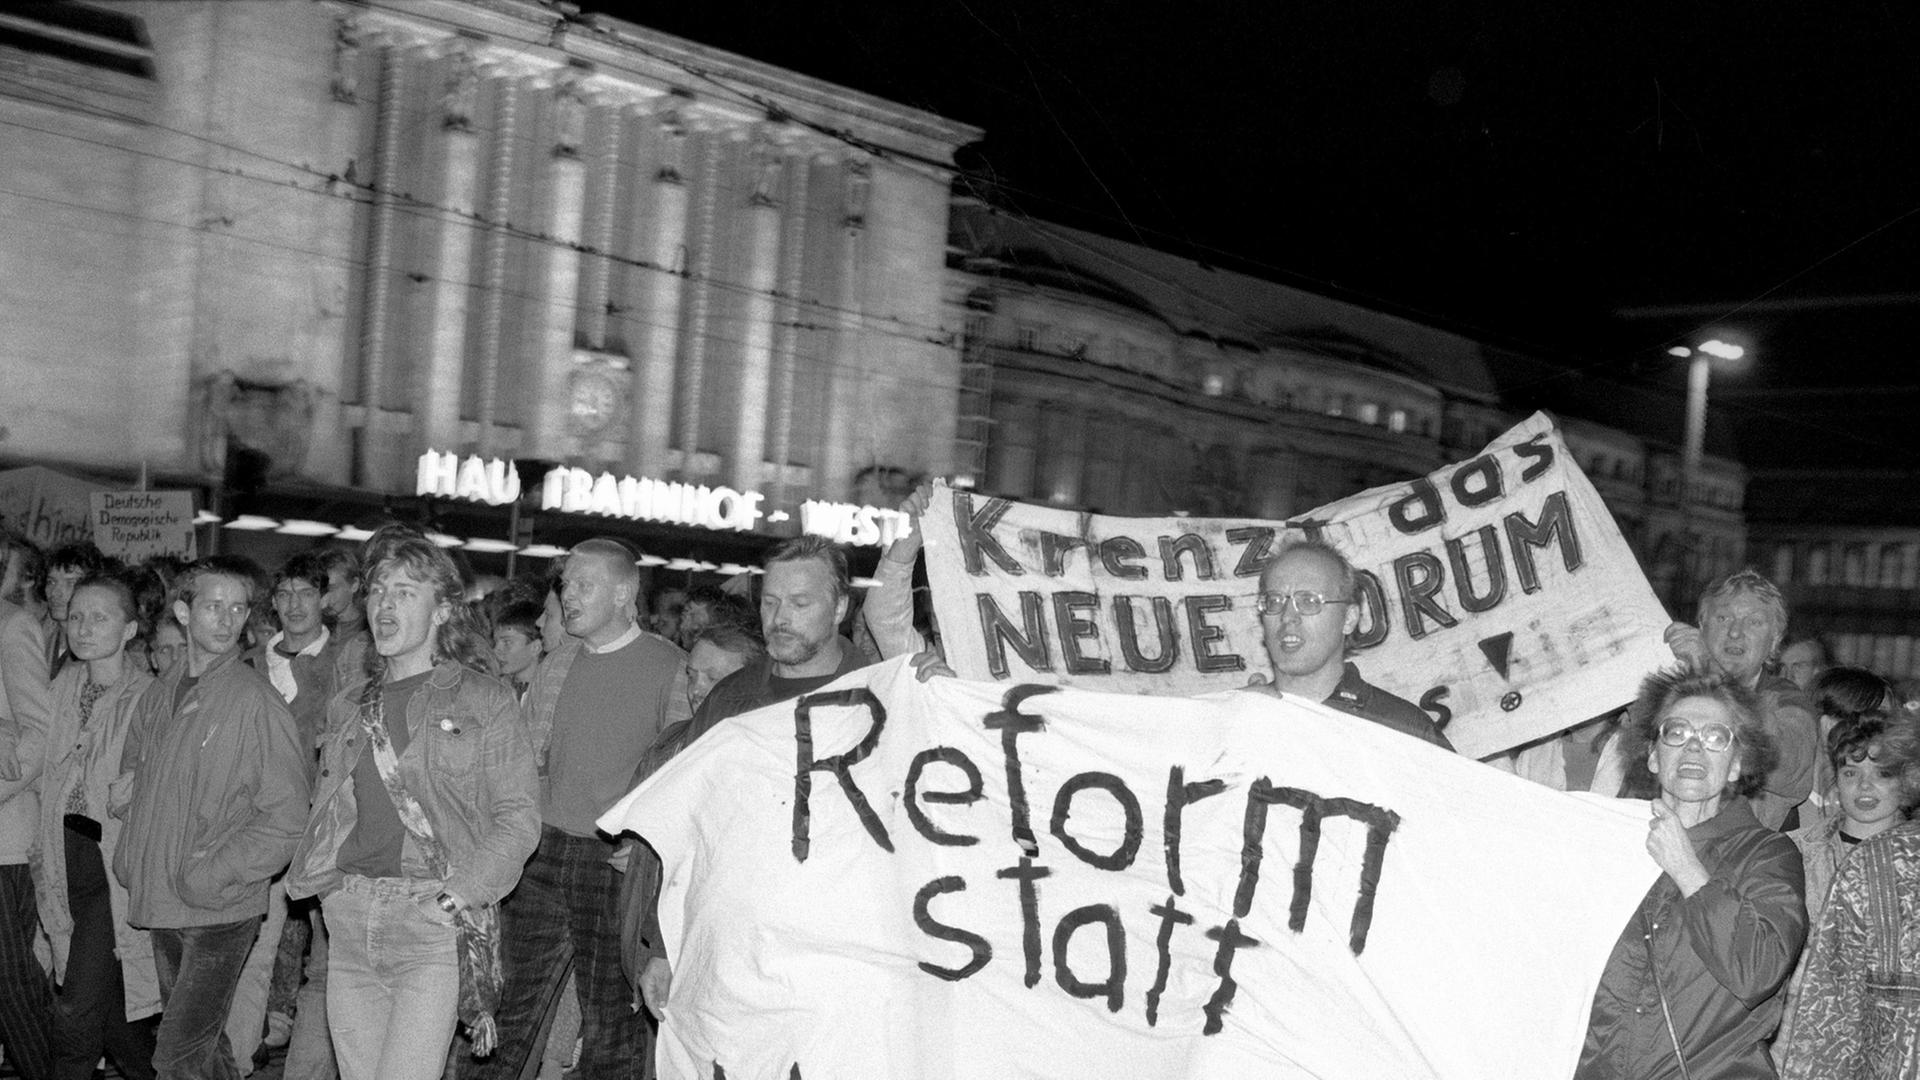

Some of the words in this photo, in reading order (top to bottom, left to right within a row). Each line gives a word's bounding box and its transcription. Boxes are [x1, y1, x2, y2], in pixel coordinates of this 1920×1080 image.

[104, 493, 162, 509] Deutsche
[112, 526, 162, 547] Republik
[416, 447, 765, 532] HAUTBAHNHOF
[952, 490, 1276, 582] Krenz
[1388, 432, 1555, 536] das
[975, 590, 1246, 681] NEUE
[1343, 490, 1584, 651] ORUM
[790, 684, 1401, 958] Reform
[912, 857, 1260, 1037] statt
